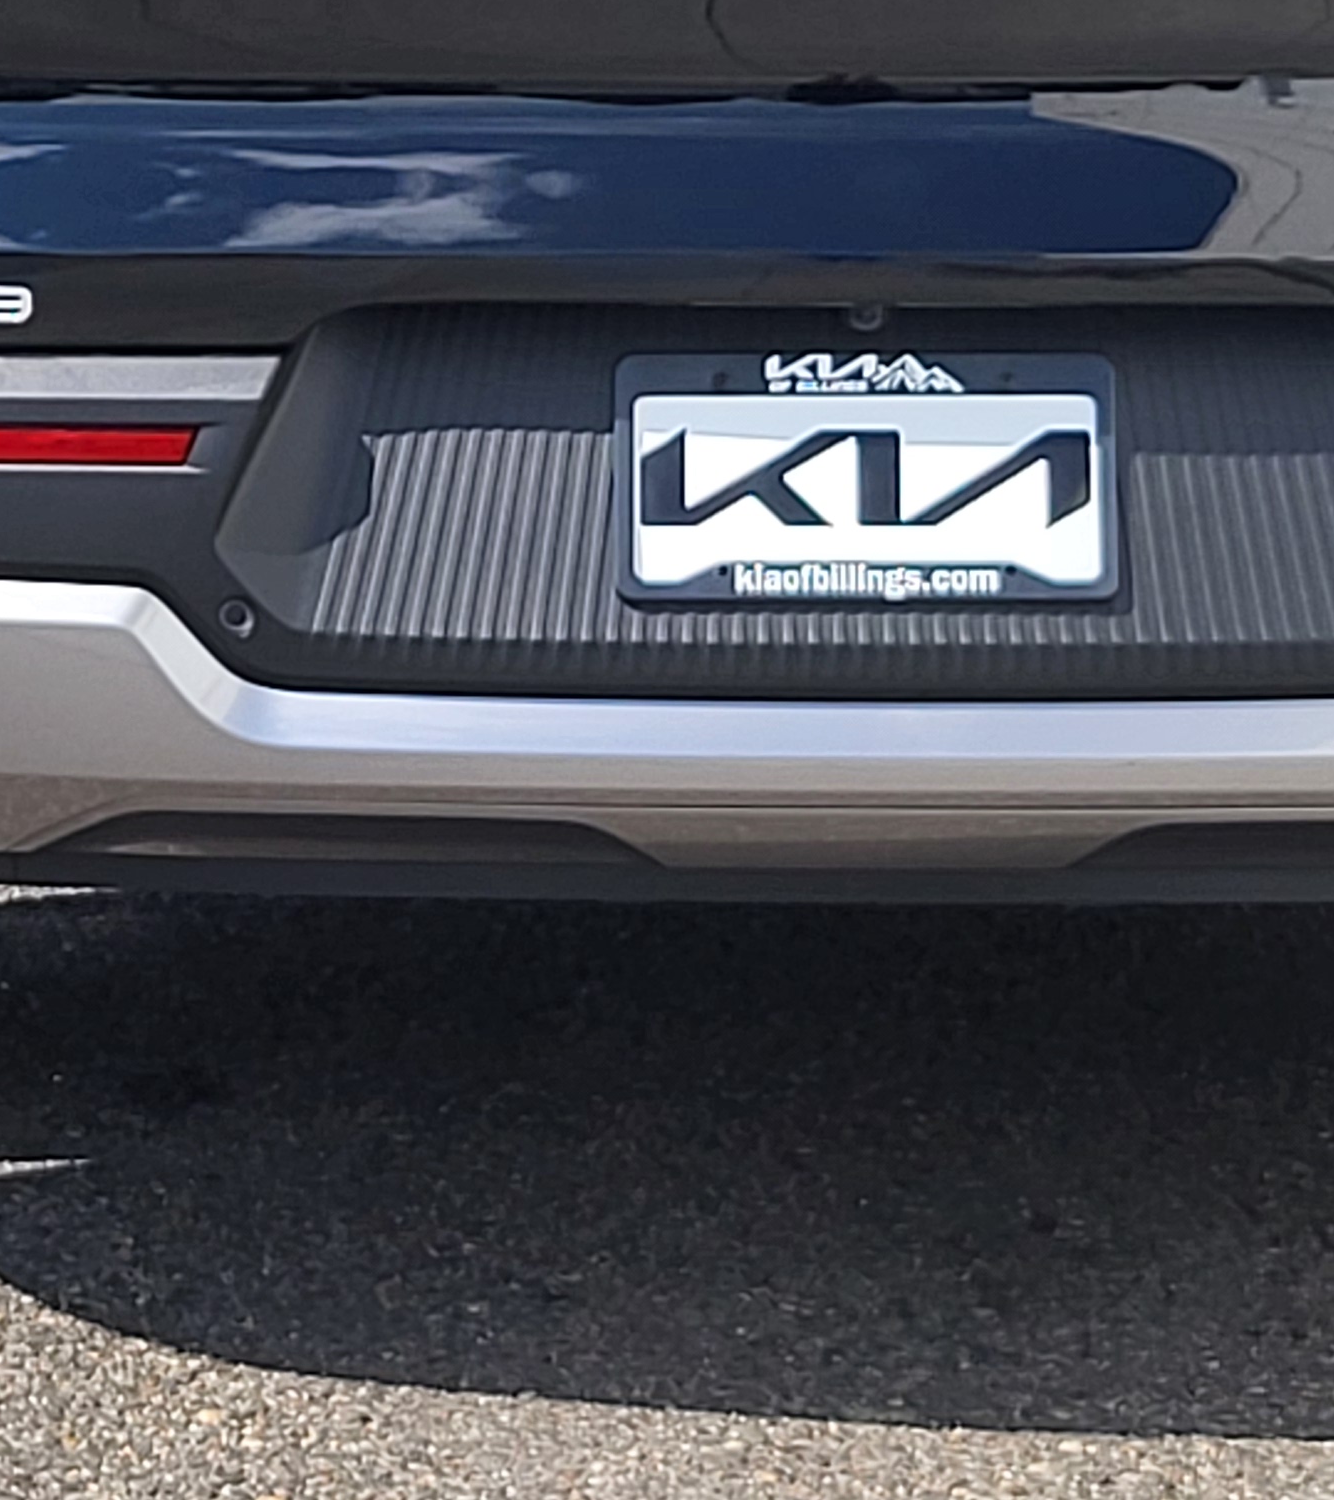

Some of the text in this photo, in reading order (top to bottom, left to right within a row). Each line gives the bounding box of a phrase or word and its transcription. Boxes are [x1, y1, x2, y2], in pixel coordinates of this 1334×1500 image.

[764, 353, 879, 380] KIA
[640, 428, 1092, 528] KIA
[733, 562, 1001, 601] kiaofbillings.com
